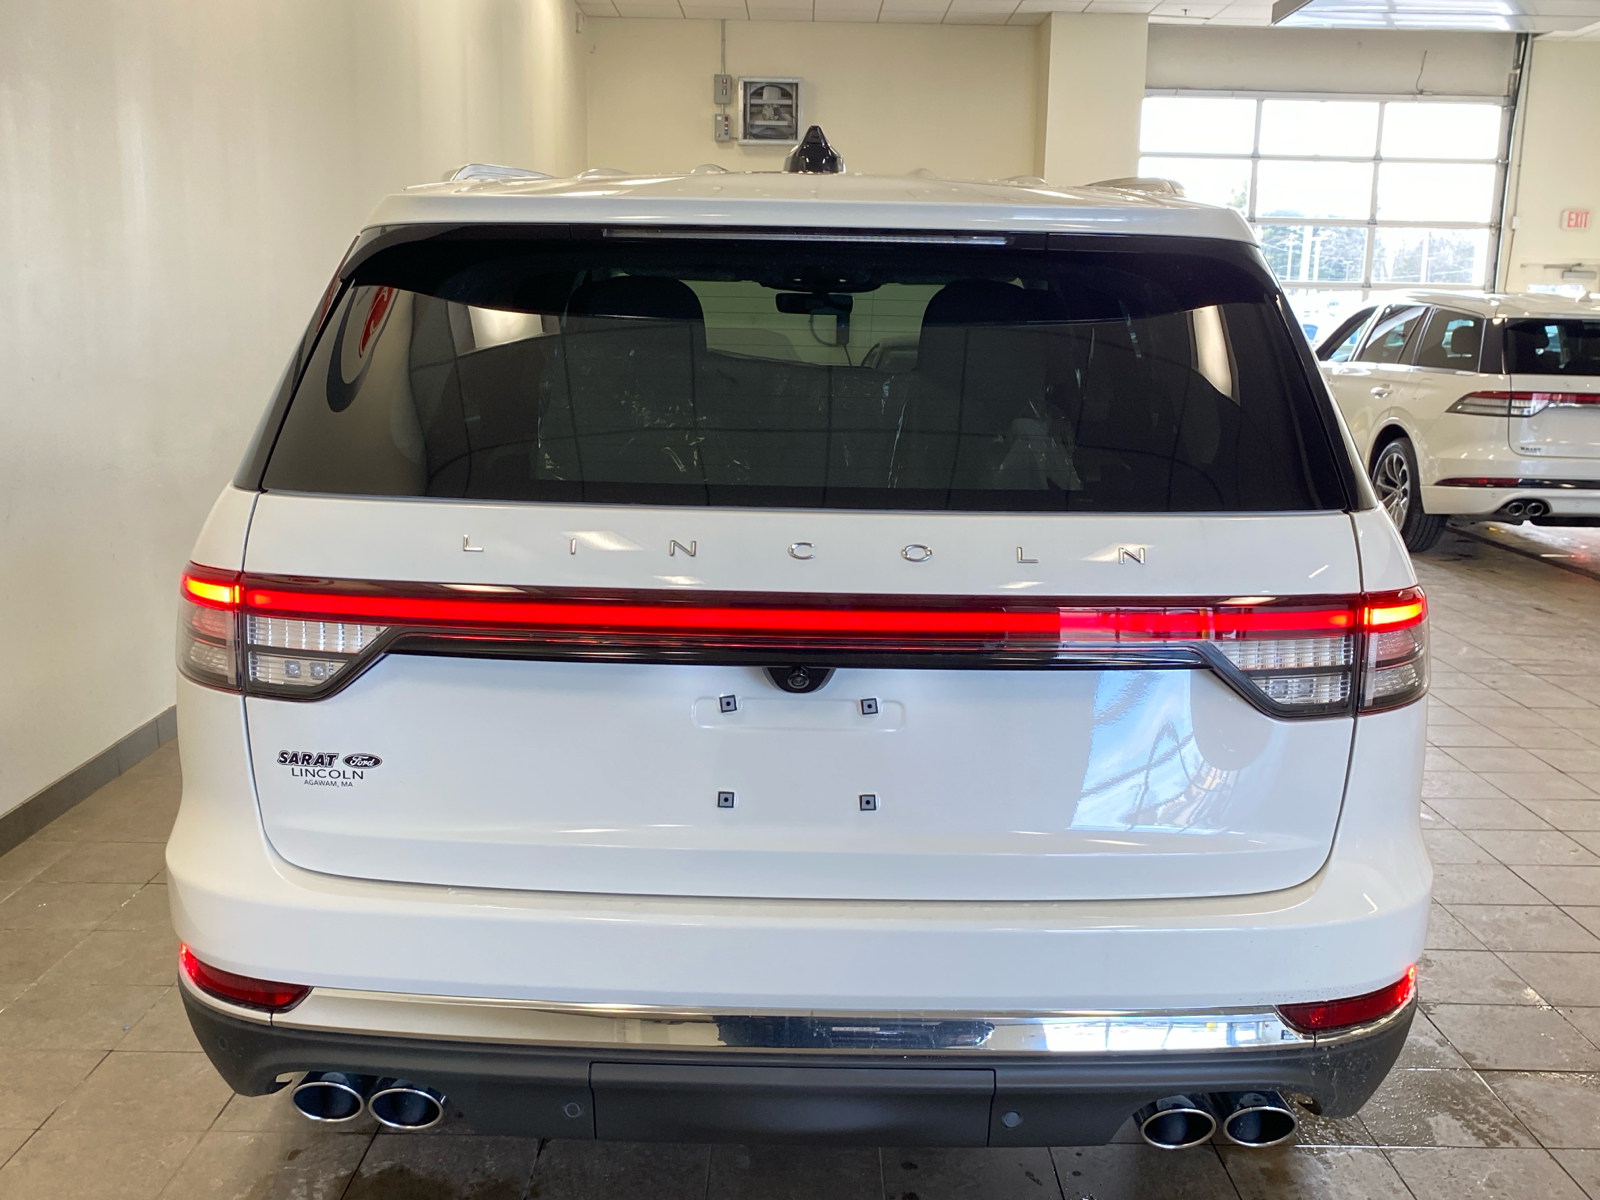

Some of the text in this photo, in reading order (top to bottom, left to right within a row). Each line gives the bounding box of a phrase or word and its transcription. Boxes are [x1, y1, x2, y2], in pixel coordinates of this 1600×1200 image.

[1567, 211, 1589, 228] EXIT
[462, 534, 1146, 565] LINCOLN
[278, 751, 338, 767] SARAT
[291, 767, 364, 780] LINCOLN
[304, 779, 339, 787] AGAWAM,
